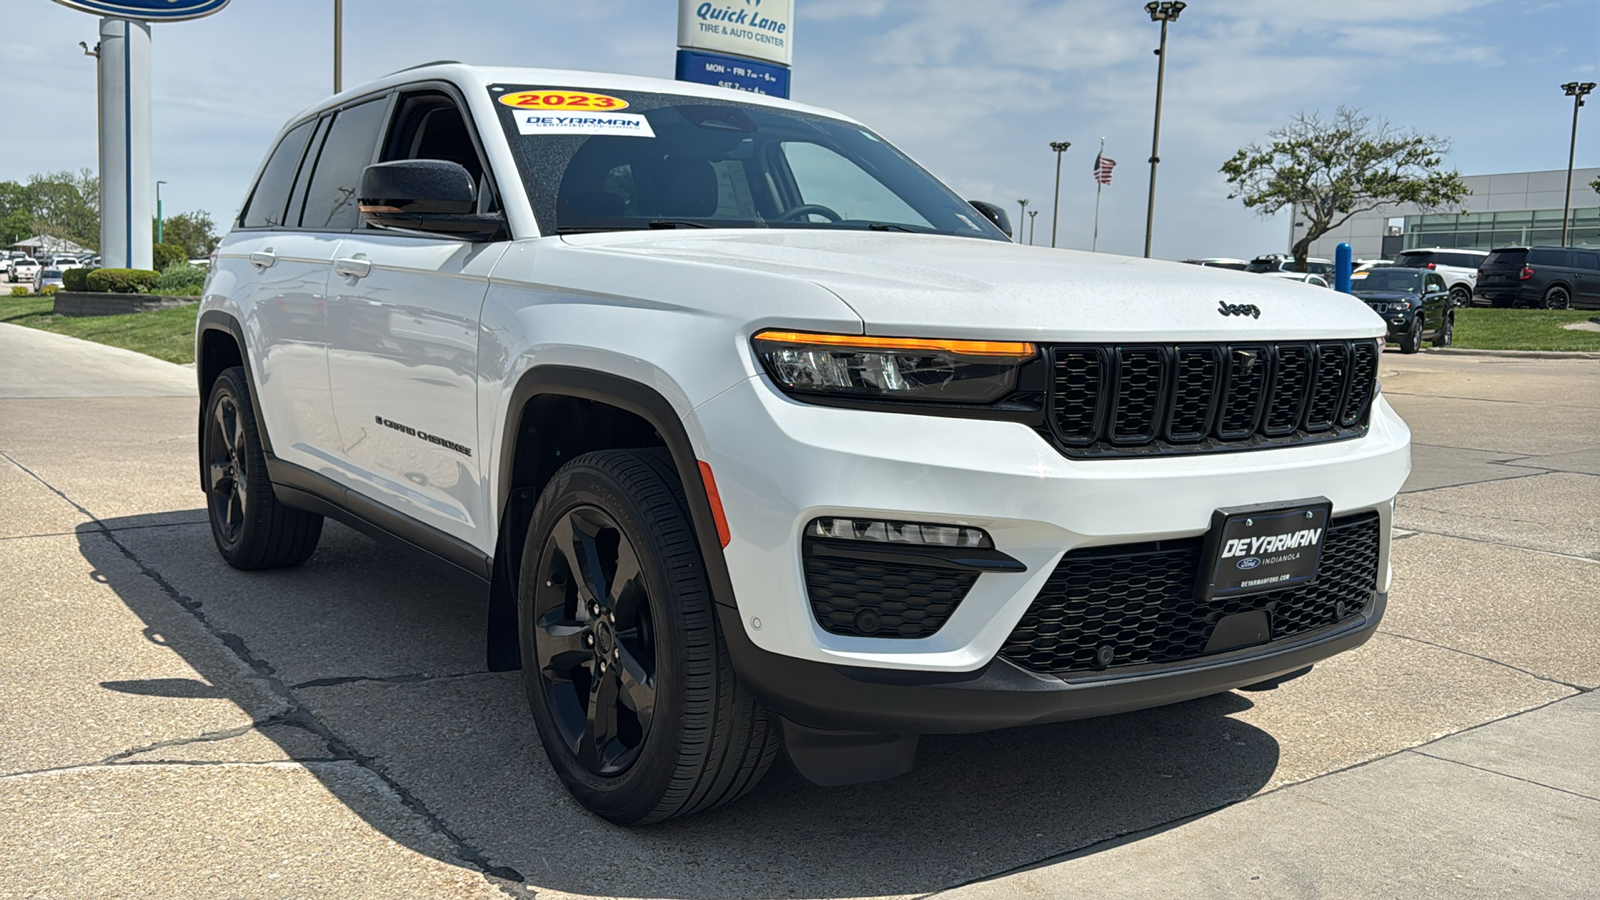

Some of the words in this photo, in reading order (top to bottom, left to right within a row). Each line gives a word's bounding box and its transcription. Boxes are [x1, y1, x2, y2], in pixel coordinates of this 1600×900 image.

[696, 2, 749, 25] Quick
[749, 12, 786, 34] Lane
[699, 22, 720, 34] TIRE
[721, 26, 728, 35] &
[729, 28, 754, 40] AUTO
[755, 32, 784, 47] CENTER
[705, 63, 724, 74] MON
[732, 67, 746, 77] FRI
[515, 94, 617, 108] 2023
[526, 116, 640, 127] DEYARMAN
[1217, 300, 1261, 320] Jeep
[383, 419, 416, 437] GRAND
[417, 430, 472, 457] CHEROKEE
[1221, 528, 1322, 559] DEYARMAN
[1262, 552, 1300, 565] INDIANOLA
[1241, 573, 1290, 588] DEYARMANFORD.COM
